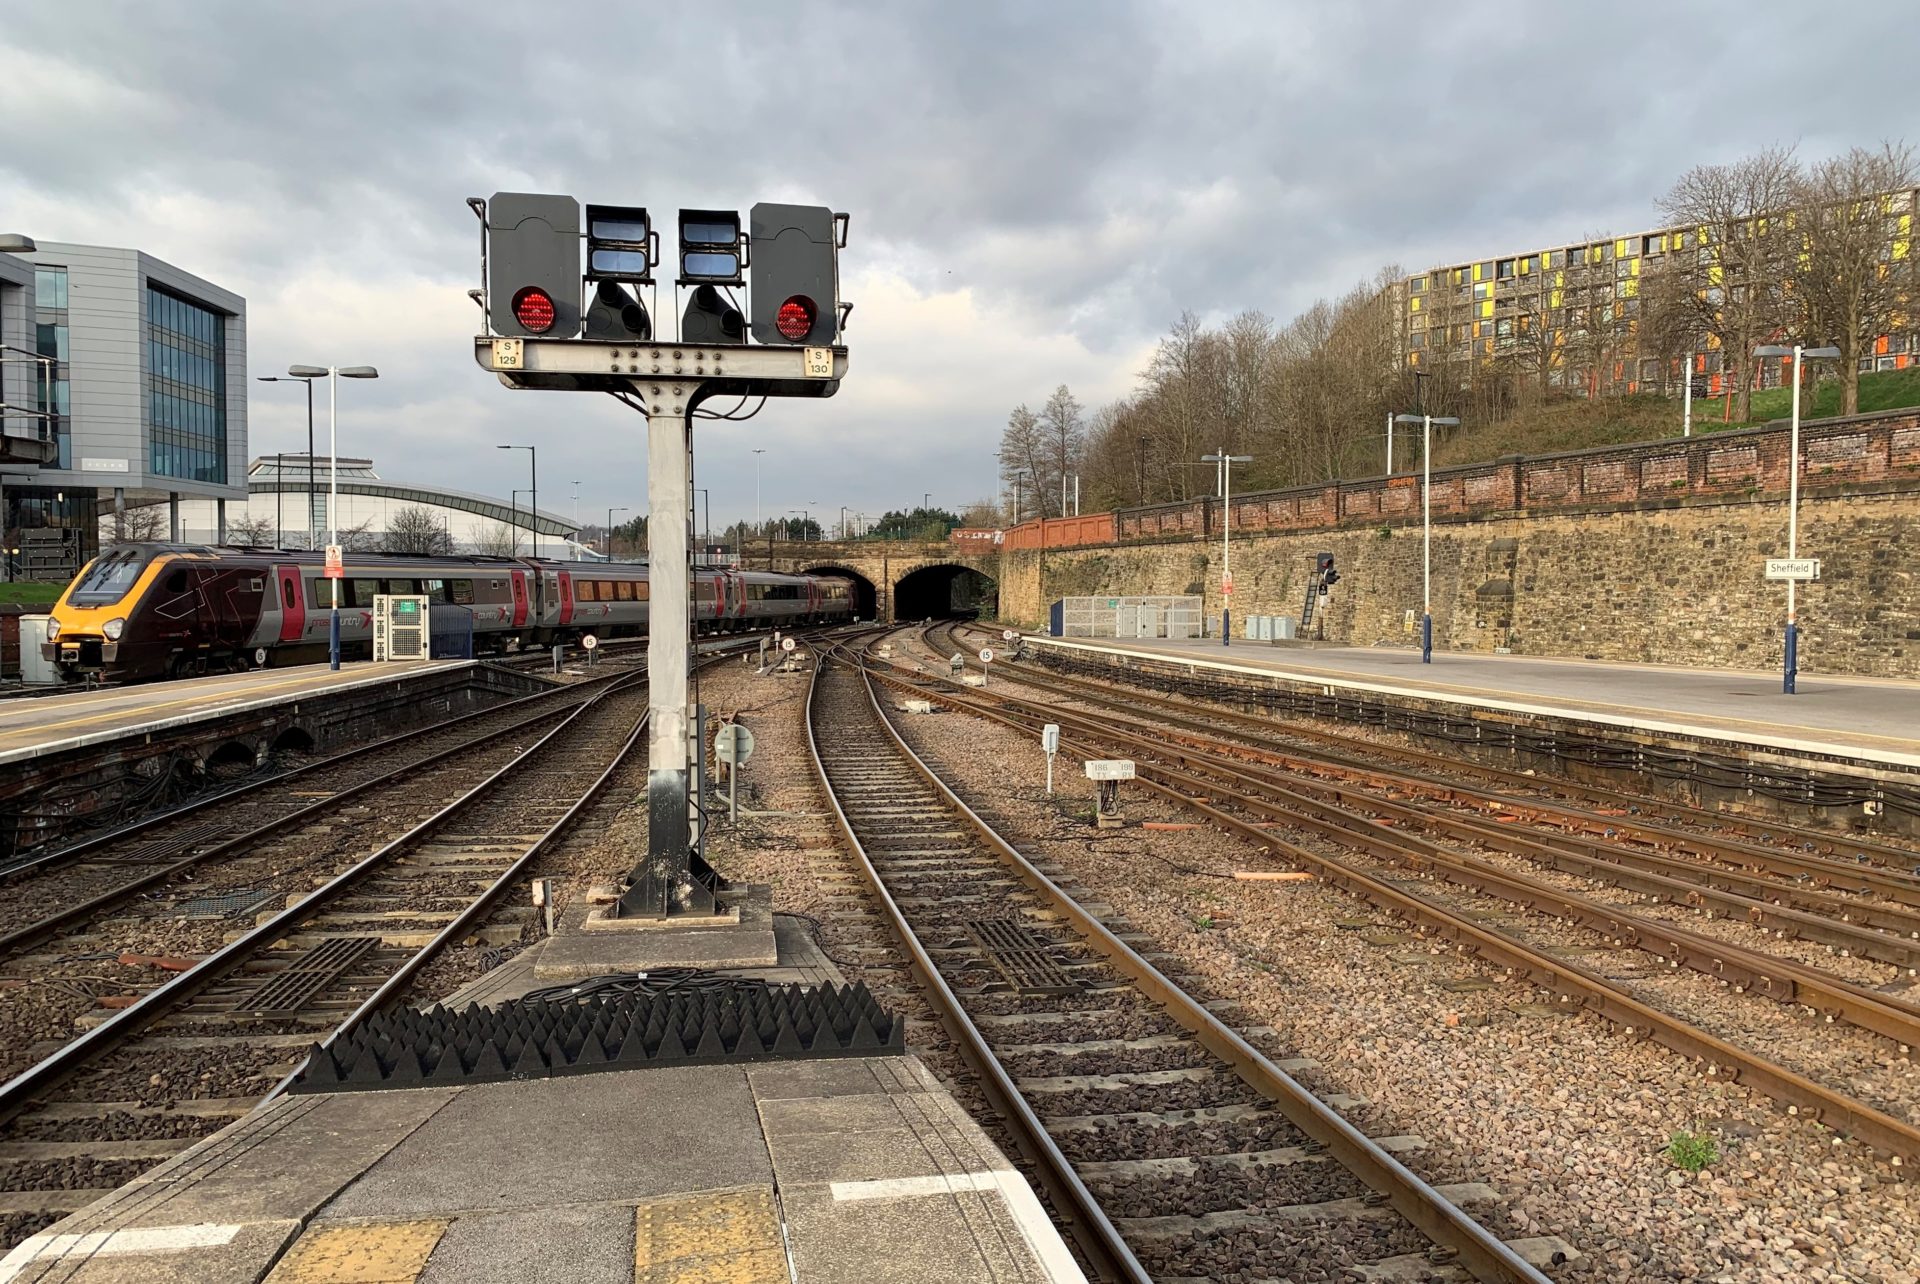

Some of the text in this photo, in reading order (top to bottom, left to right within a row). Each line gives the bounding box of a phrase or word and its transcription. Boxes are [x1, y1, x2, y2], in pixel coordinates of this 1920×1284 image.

[504, 341, 511, 351] S
[499, 355, 517, 365] 129
[815, 351, 822, 360] S
[810, 364, 828, 374] 130
[1771, 563, 1809, 573] Sheffield
[586, 638, 593, 646] 15
[785, 640, 792, 648] 15
[982, 651, 990, 660] 15
